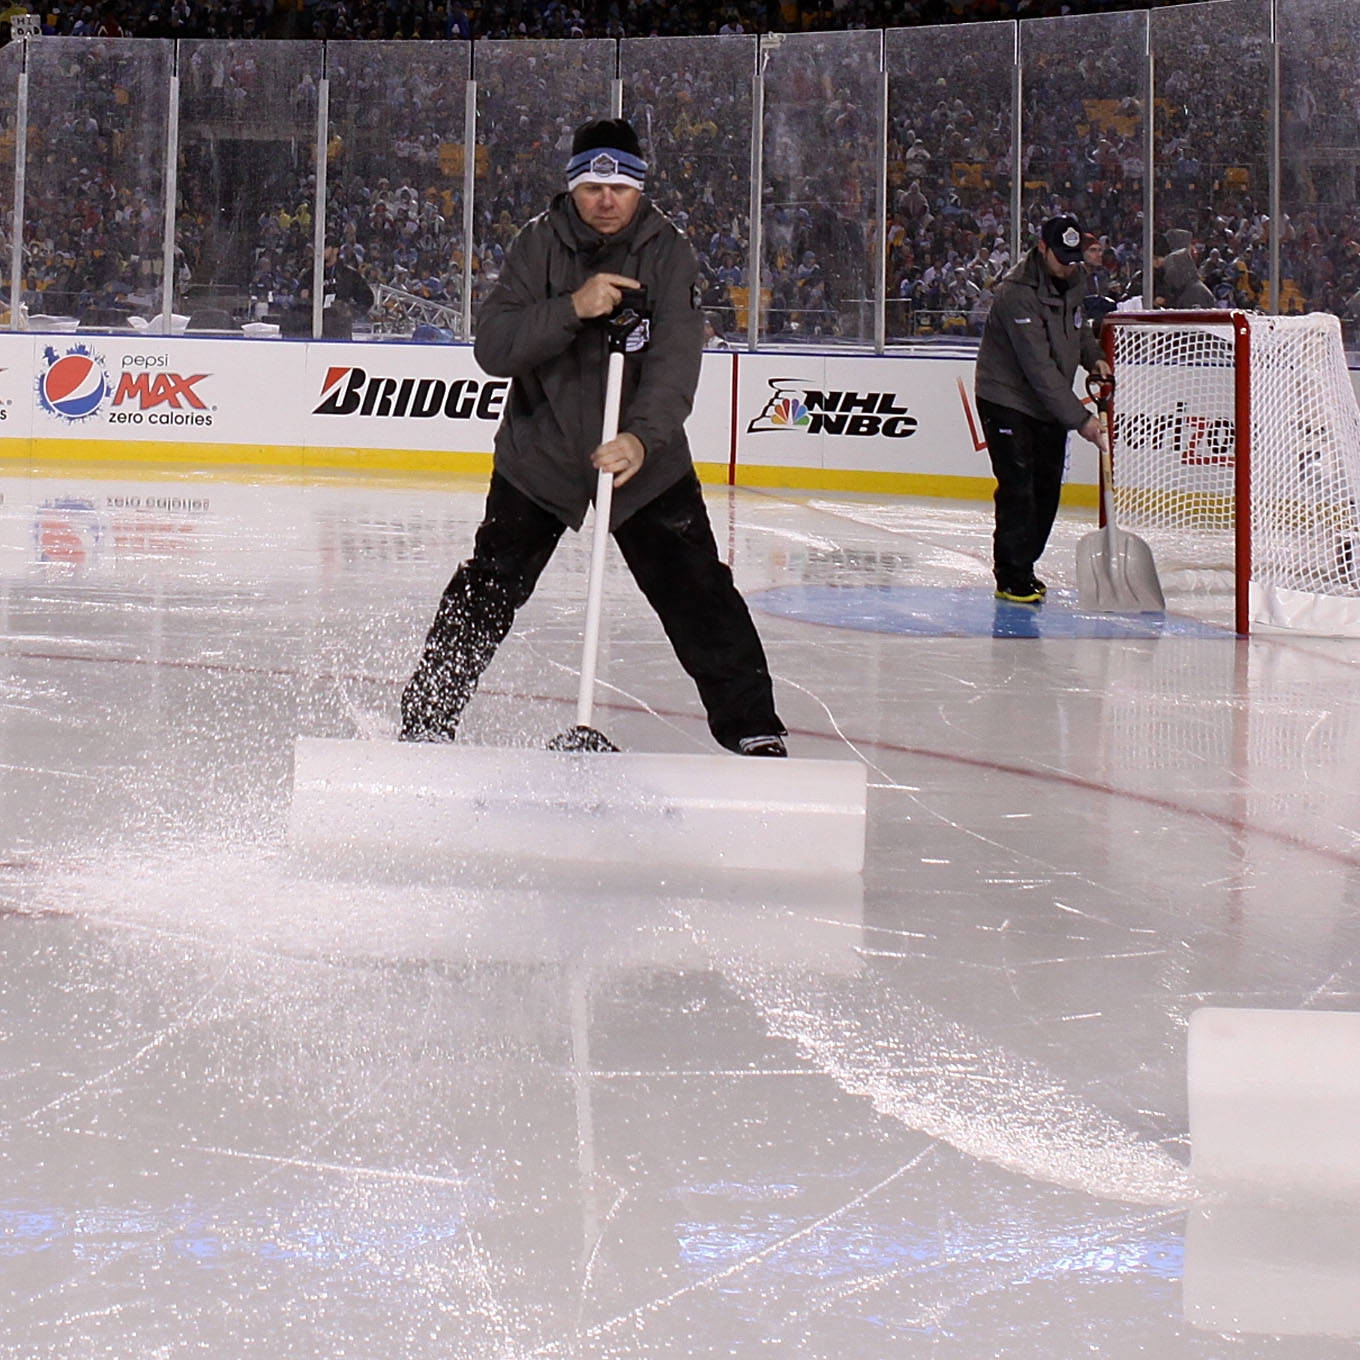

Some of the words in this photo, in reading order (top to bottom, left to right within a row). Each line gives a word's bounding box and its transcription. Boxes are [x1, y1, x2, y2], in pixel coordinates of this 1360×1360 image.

[121, 354, 168, 368] pepsi
[111, 372, 214, 410] MAX
[802, 390, 908, 414] NHL
[108, 412, 143, 424] zero
[148, 411, 213, 426] calories
[807, 413, 918, 438] NBC
